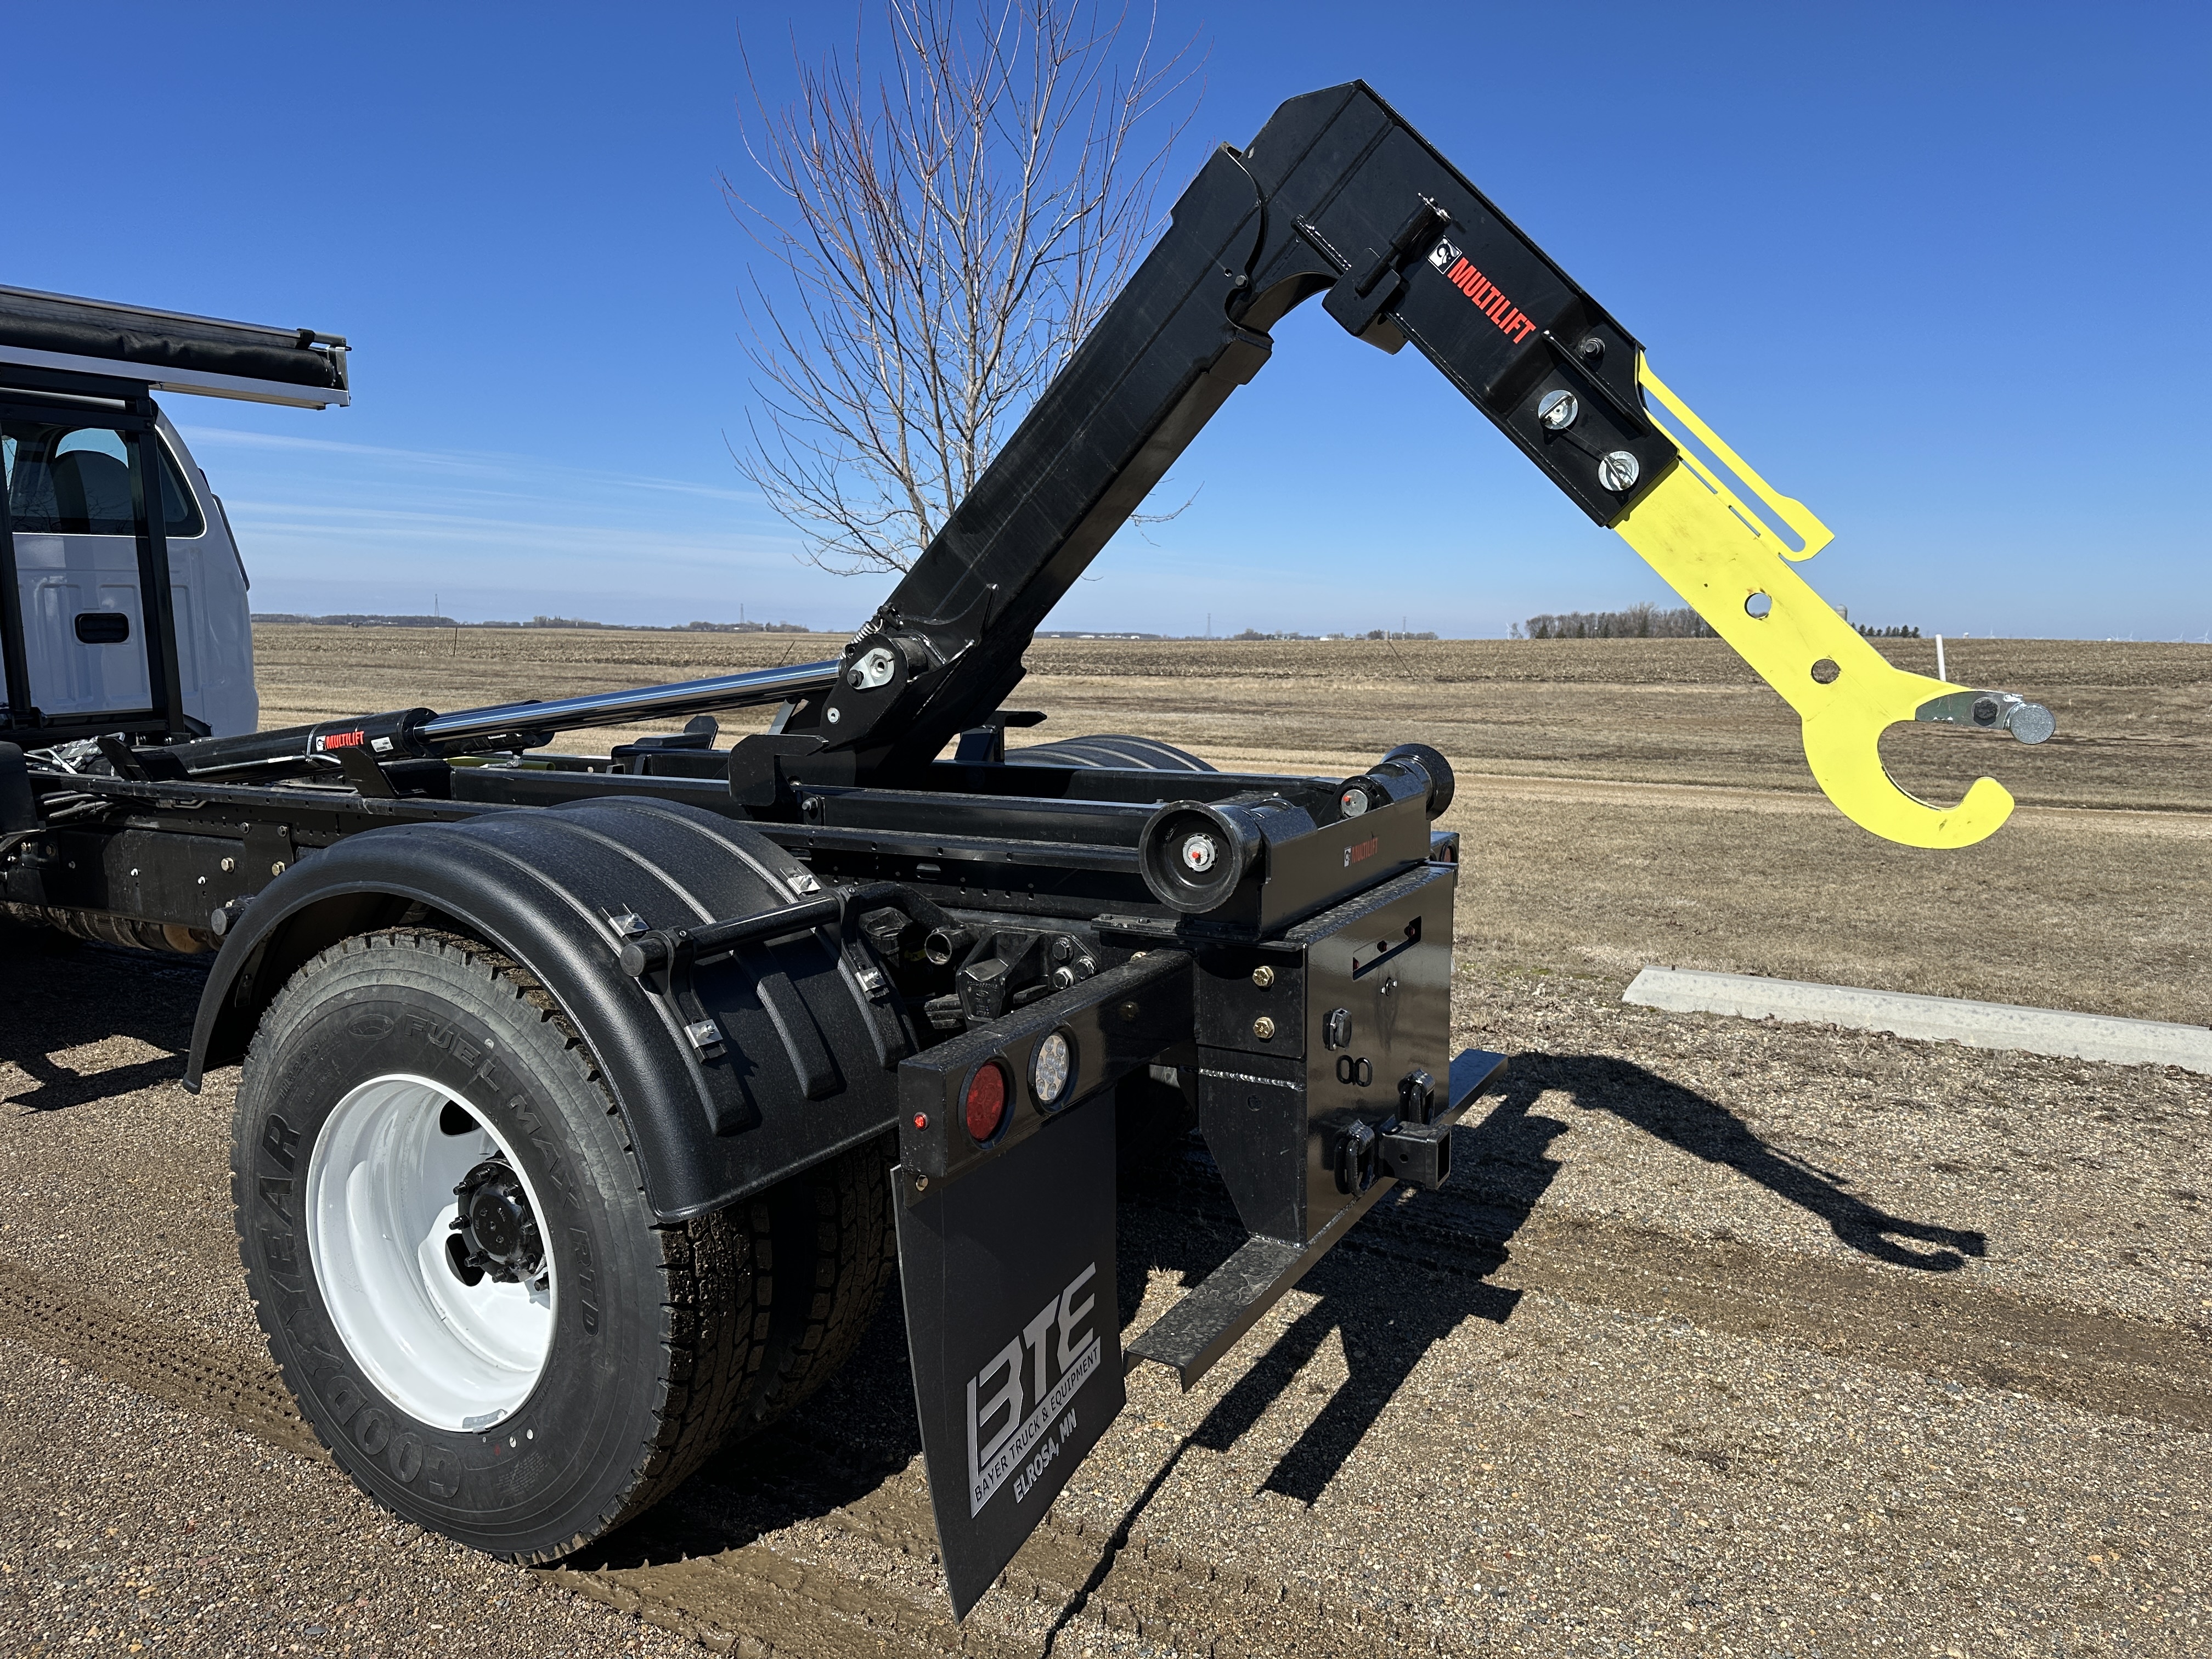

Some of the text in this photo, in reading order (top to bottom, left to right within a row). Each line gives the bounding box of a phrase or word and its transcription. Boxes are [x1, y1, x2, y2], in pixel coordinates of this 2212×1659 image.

[1447, 257, 1537, 345] MULTILIFT
[326, 731, 364, 749] MULTILIFT
[1352, 837, 1378, 864] MULTILIFT
[404, 1014, 599, 1337] FUEL MAX RTD
[967, 1261, 1096, 1477] BTE
[974, 1346, 1098, 1502] BAYER TRUCK & EQUIPMENT
[1013, 1407, 1077, 1504] ELROSA, MN
